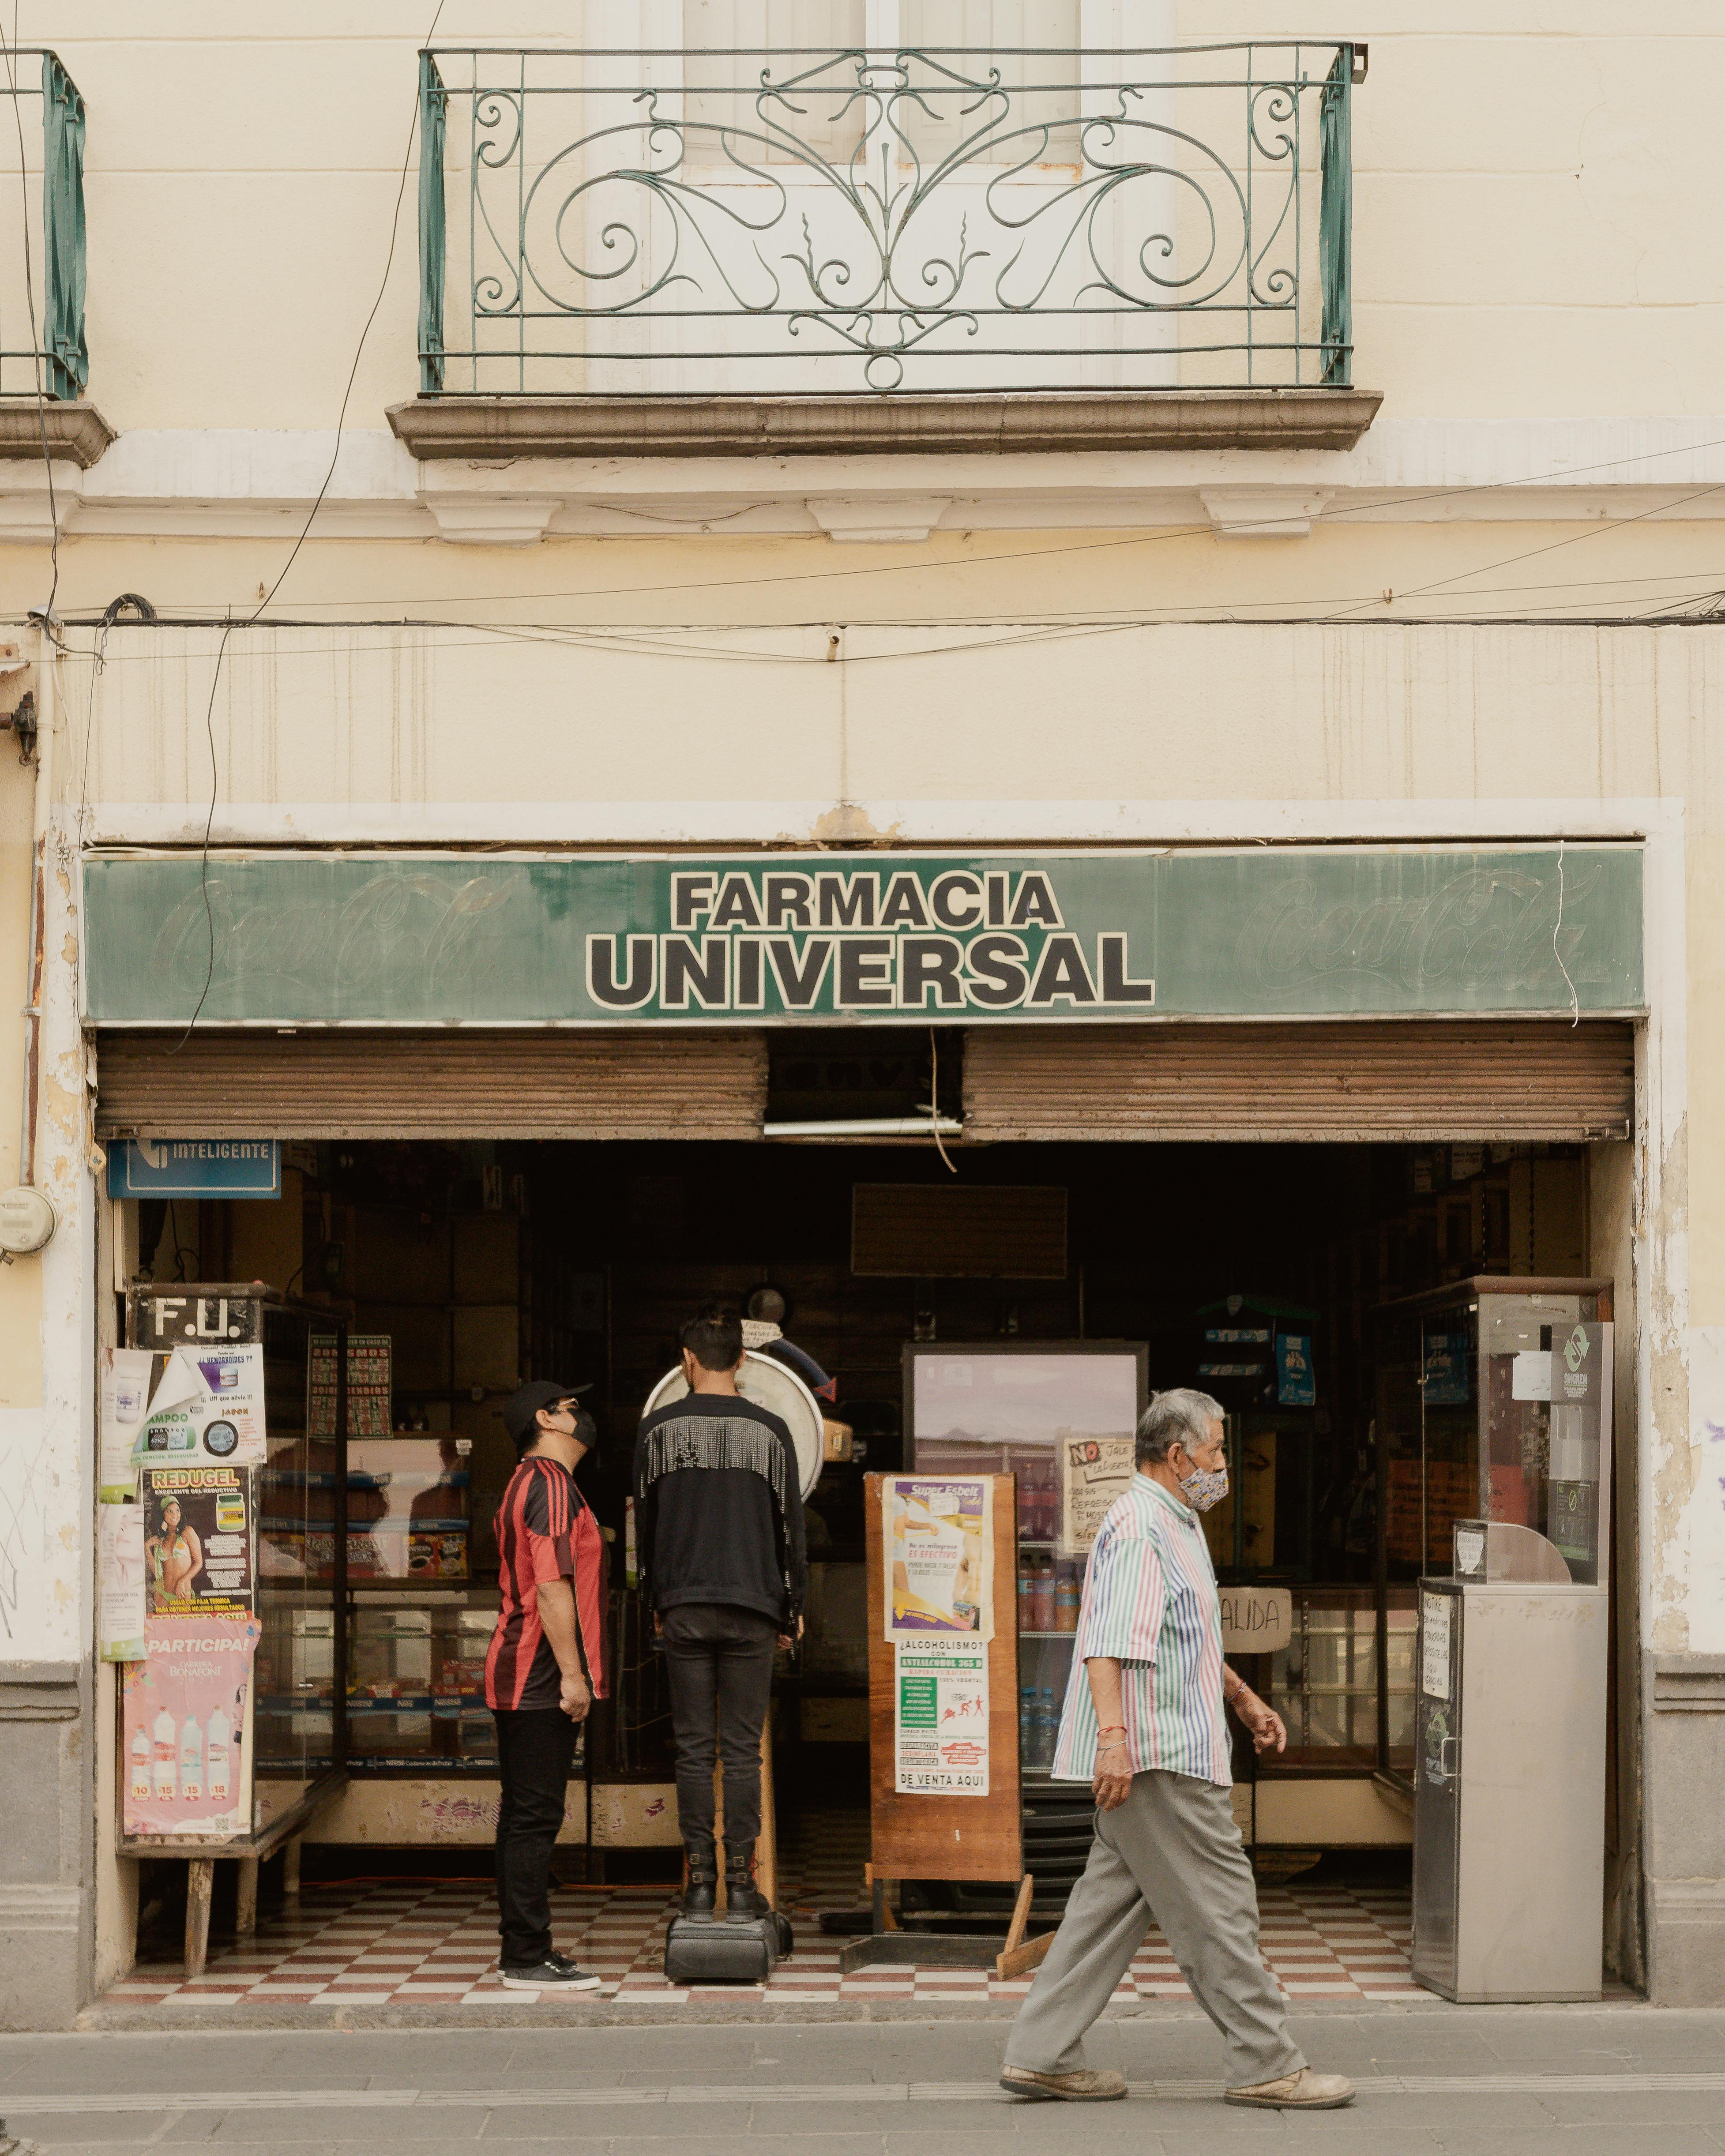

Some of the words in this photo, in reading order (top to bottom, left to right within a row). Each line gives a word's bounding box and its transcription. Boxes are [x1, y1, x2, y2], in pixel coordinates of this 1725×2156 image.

[671, 870, 1065, 931] FARMACIA
[586, 932, 1155, 1010] UNIVERSAL
[174, 1142, 269, 1159] INTELIGENTE
[155, 1298, 241, 1337] F.U.
[1564, 1373, 1588, 1385] SINGREM
[147, 1413, 188, 1424] AMPOO
[1070, 1442, 1099, 1465] NO
[1107, 1444, 1129, 1457] JALE
[152, 1469, 240, 1488] REDUGEL
[910, 1484, 941, 1496] Super
[945, 1485, 980, 1497] Esbelt
[1086, 1510, 1108, 1520] MOST
[908, 1550, 917, 1559] ES
[920, 1550, 958, 1559] EFECTIVO
[1221, 1597, 1281, 1631] ALIDA
[900, 1641, 983, 1651] ¿ALCOHOLISMO?
[902, 1658, 956, 1667] ANTIALCOHOL
[169, 1666, 222, 1677] BONAFONT
[901, 1774, 913, 1784] DE
[918, 1774, 952, 1785] VENTA
[957, 1775, 984, 1786] AQUI
